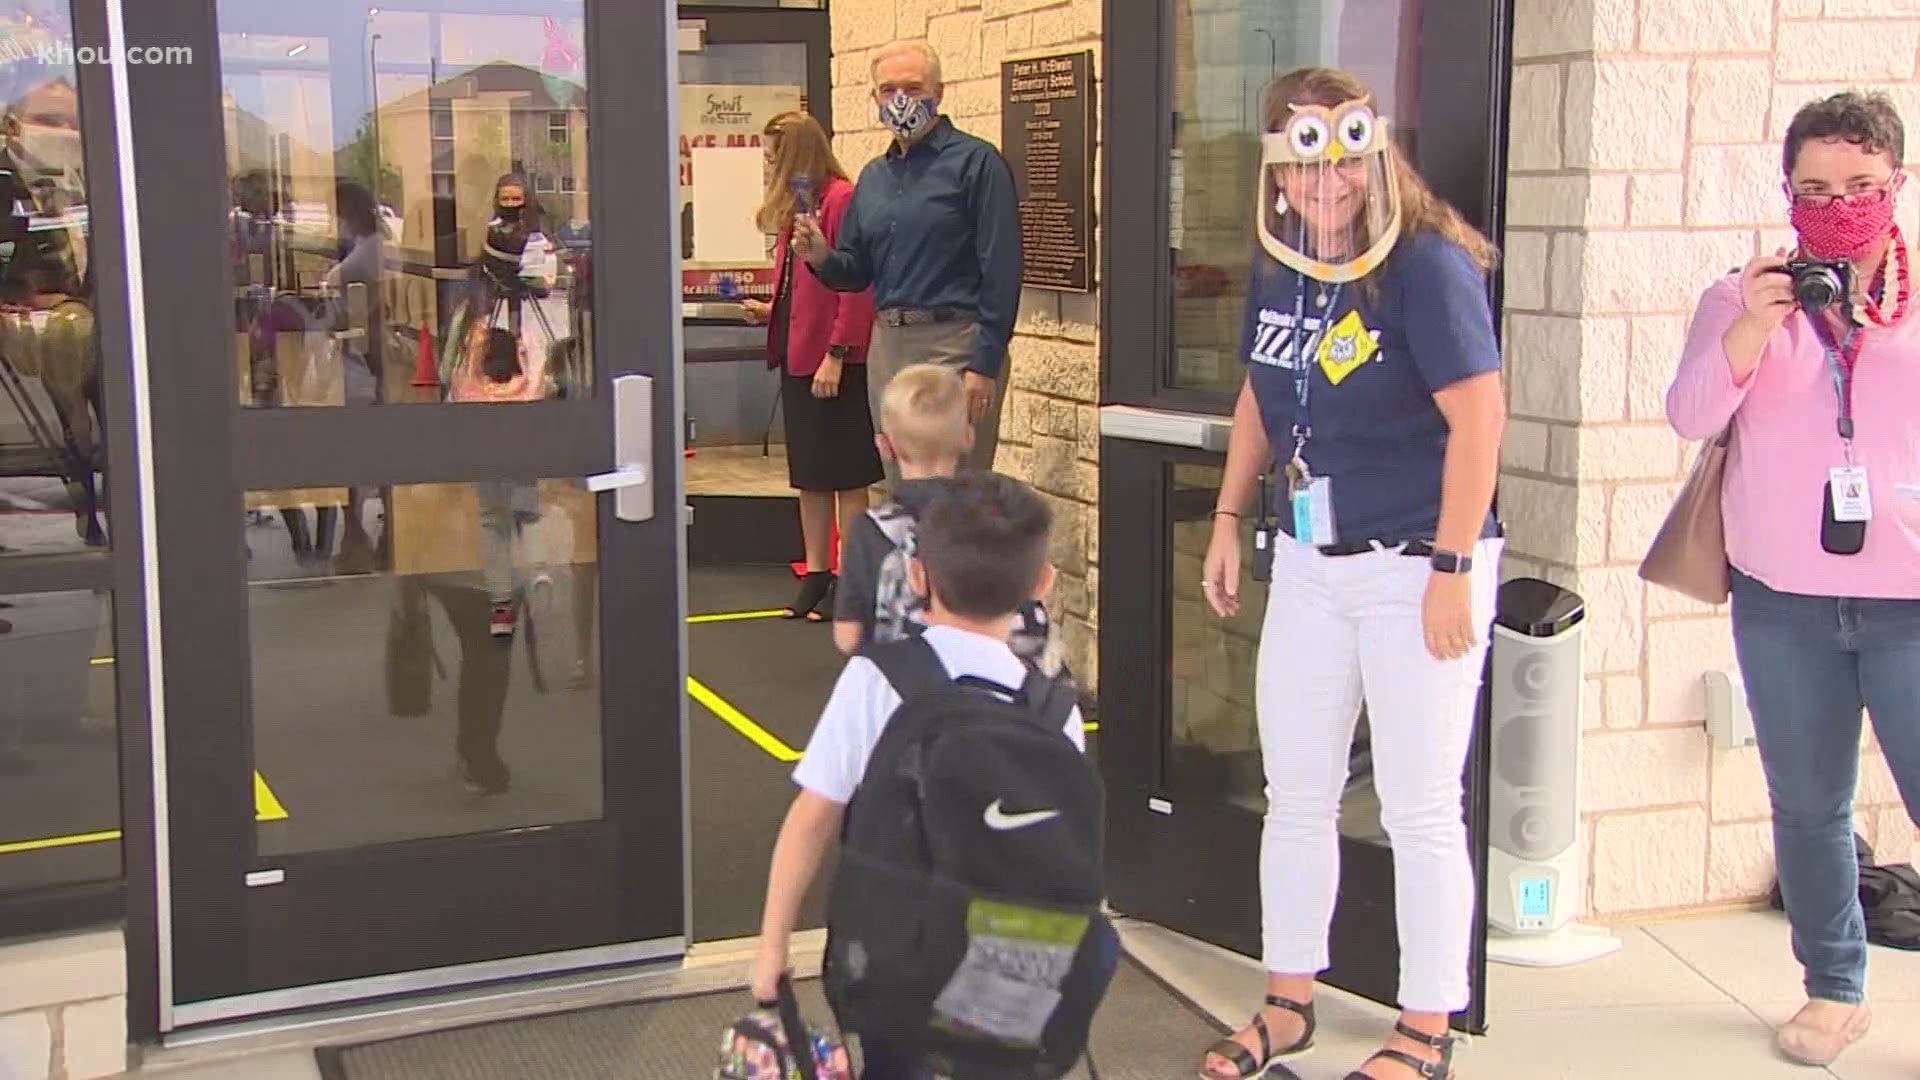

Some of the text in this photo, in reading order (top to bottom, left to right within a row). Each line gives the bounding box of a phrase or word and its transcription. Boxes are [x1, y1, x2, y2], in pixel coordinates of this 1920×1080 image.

[1012, 72, 1074, 92] Elementary School
[727, 133, 761, 148] MA
